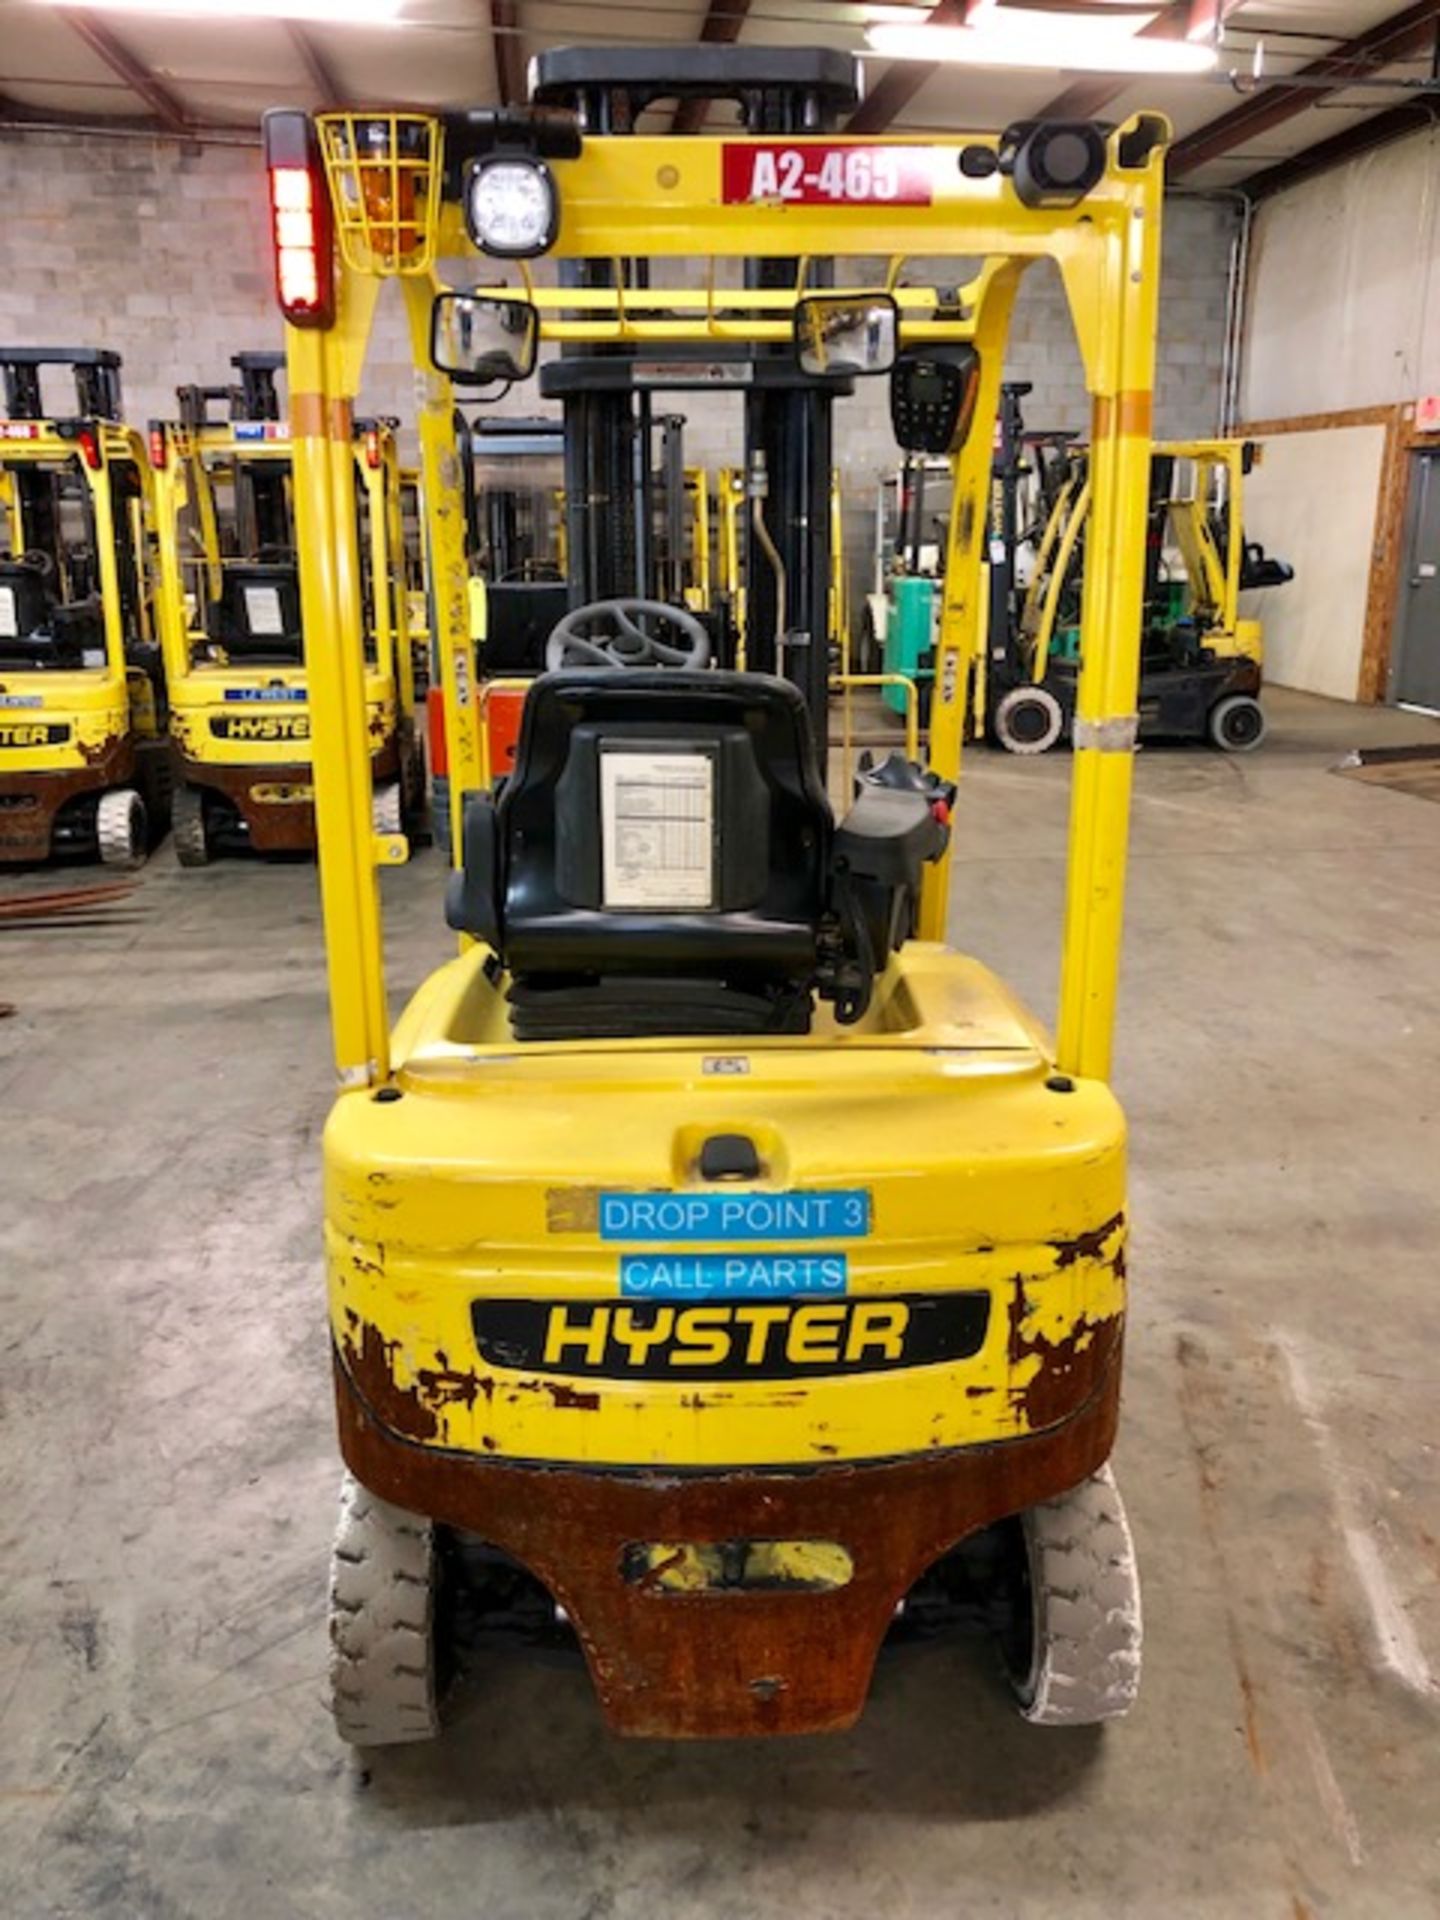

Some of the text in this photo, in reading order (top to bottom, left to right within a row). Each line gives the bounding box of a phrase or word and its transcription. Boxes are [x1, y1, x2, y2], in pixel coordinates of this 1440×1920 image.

[752, 150, 899, 199] A2-465
[605, 1198, 862, 1231] DROP POINT 3
[624, 1258, 843, 1290] CALL PARTS
[544, 1303, 908, 1365] HYSTER
